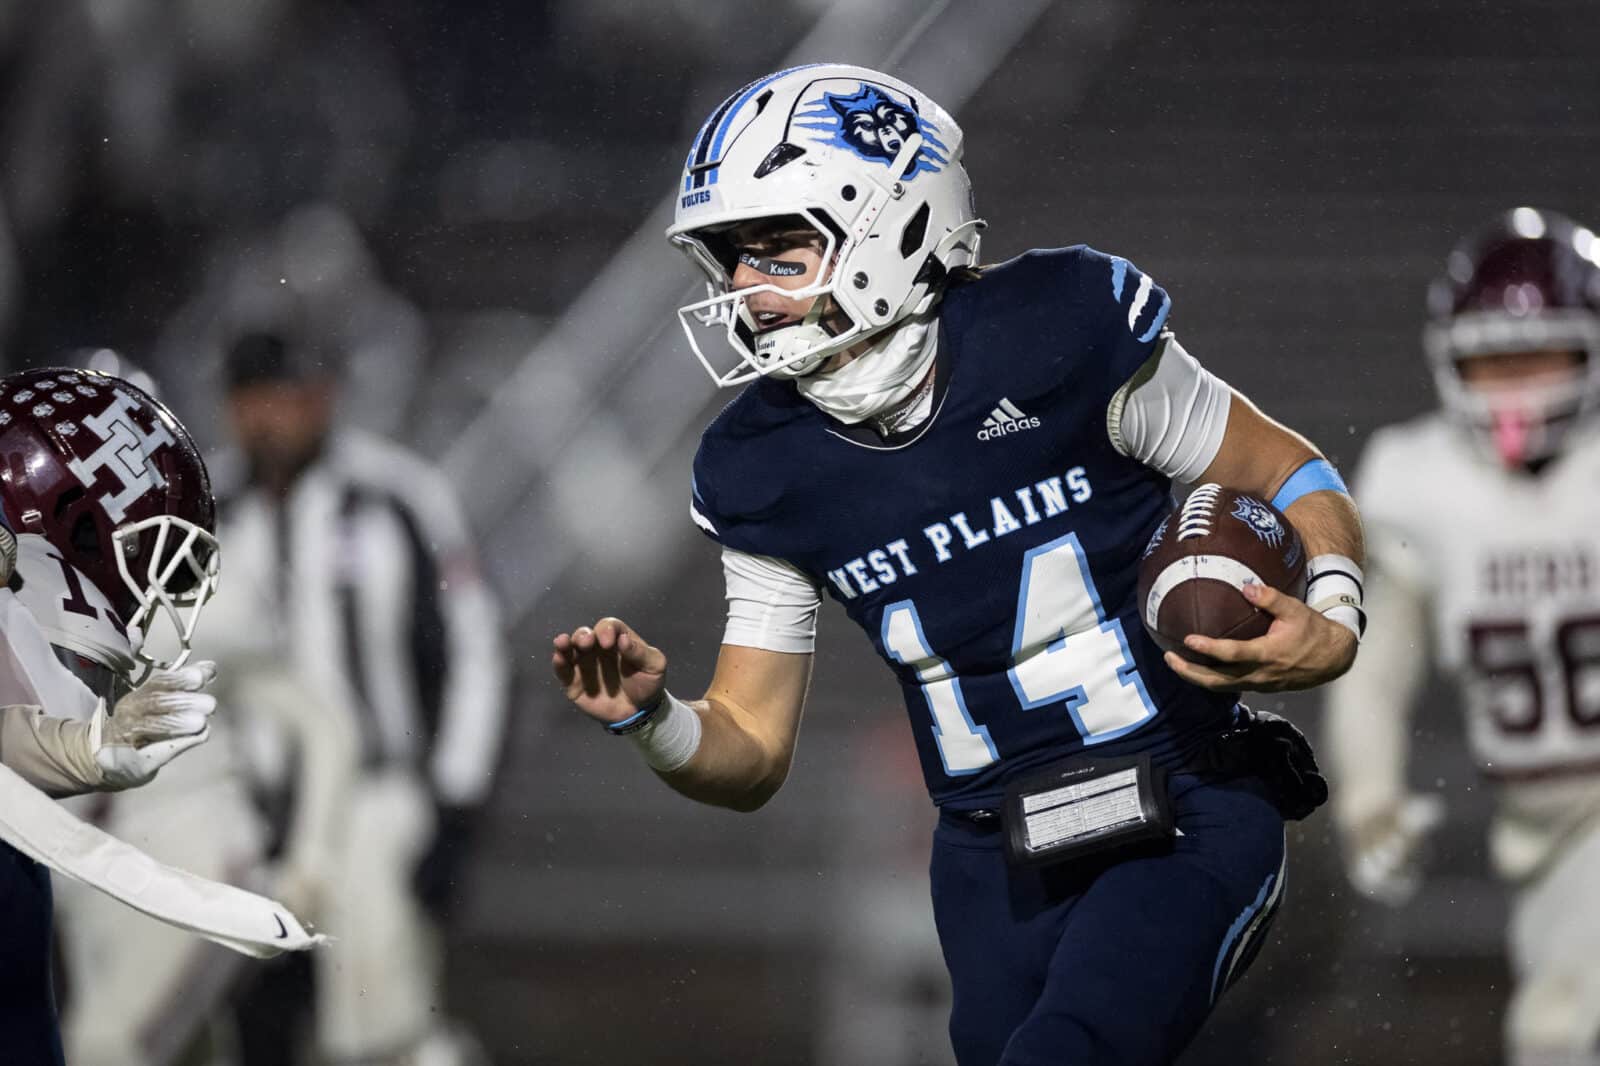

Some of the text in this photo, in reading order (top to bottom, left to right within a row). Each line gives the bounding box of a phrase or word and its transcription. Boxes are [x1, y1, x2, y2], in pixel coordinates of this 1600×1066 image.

[681, 189, 711, 209] WOLVES
[976, 416, 1041, 441] adidas
[923, 465, 1093, 564] PLAINS
[880, 531, 1158, 777] 14
